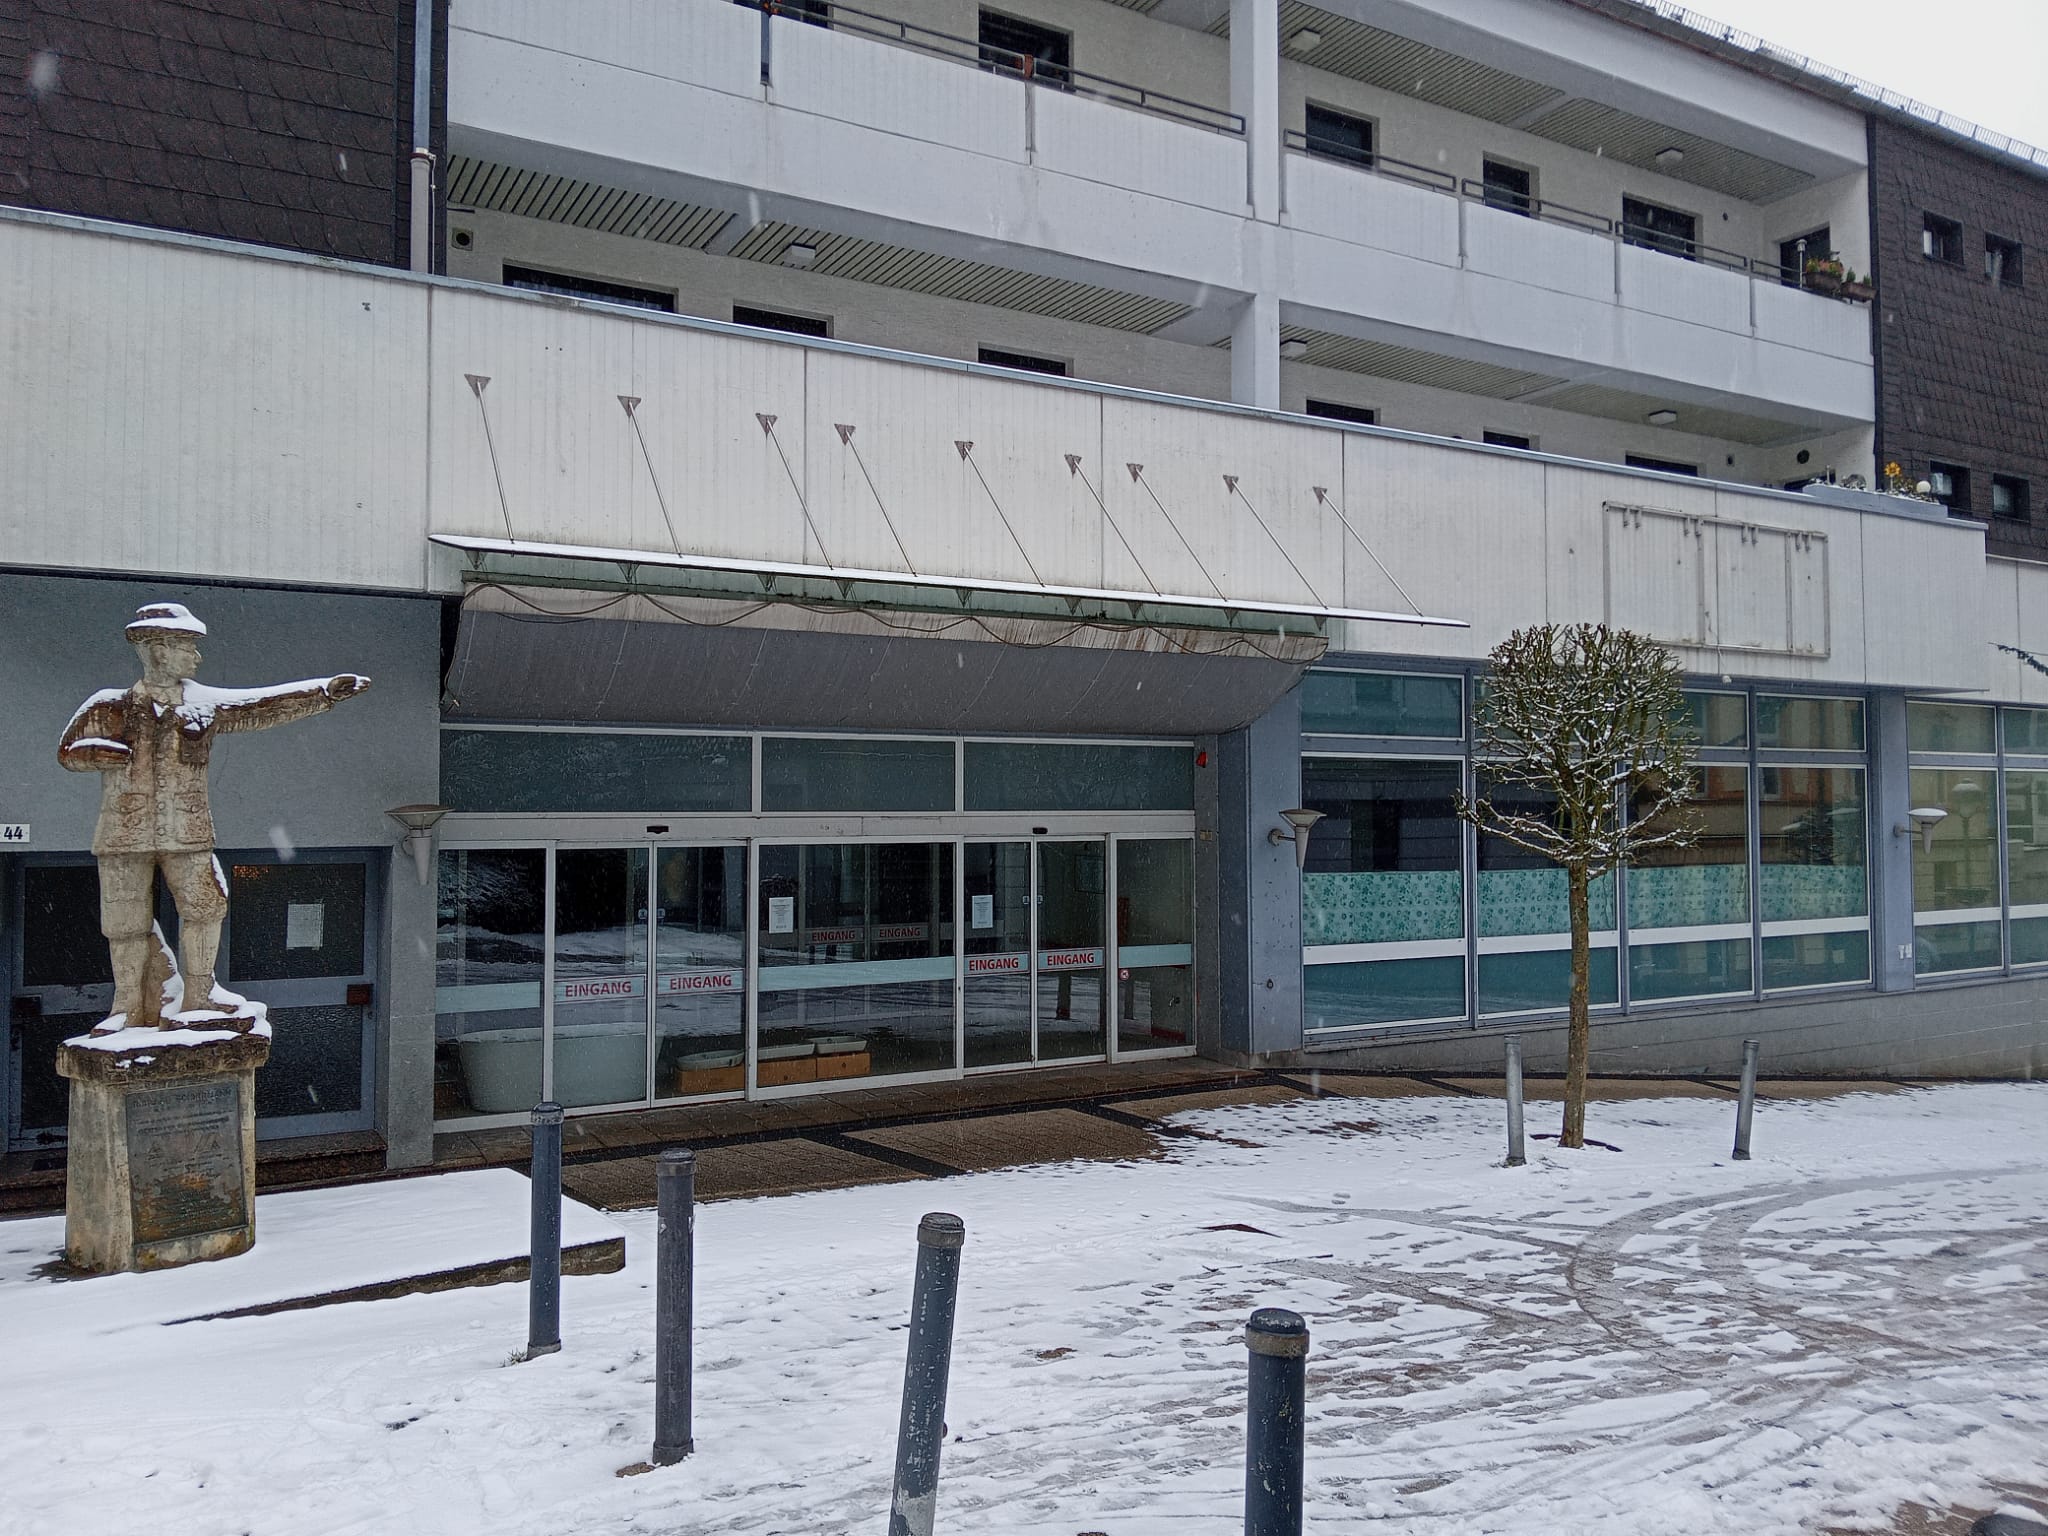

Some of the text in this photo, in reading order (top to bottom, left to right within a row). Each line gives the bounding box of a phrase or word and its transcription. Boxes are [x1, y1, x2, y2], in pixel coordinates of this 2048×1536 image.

[4, 826, 23, 840] 44
[812, 930, 856, 942] EINGANG
[879, 927, 921, 938] EINGANG
[968, 957, 1019, 971] EINGANG
[1047, 952, 1095, 966] EINGANG
[565, 981, 632, 998] EINGANG
[670, 974, 732, 991] EINGANG
